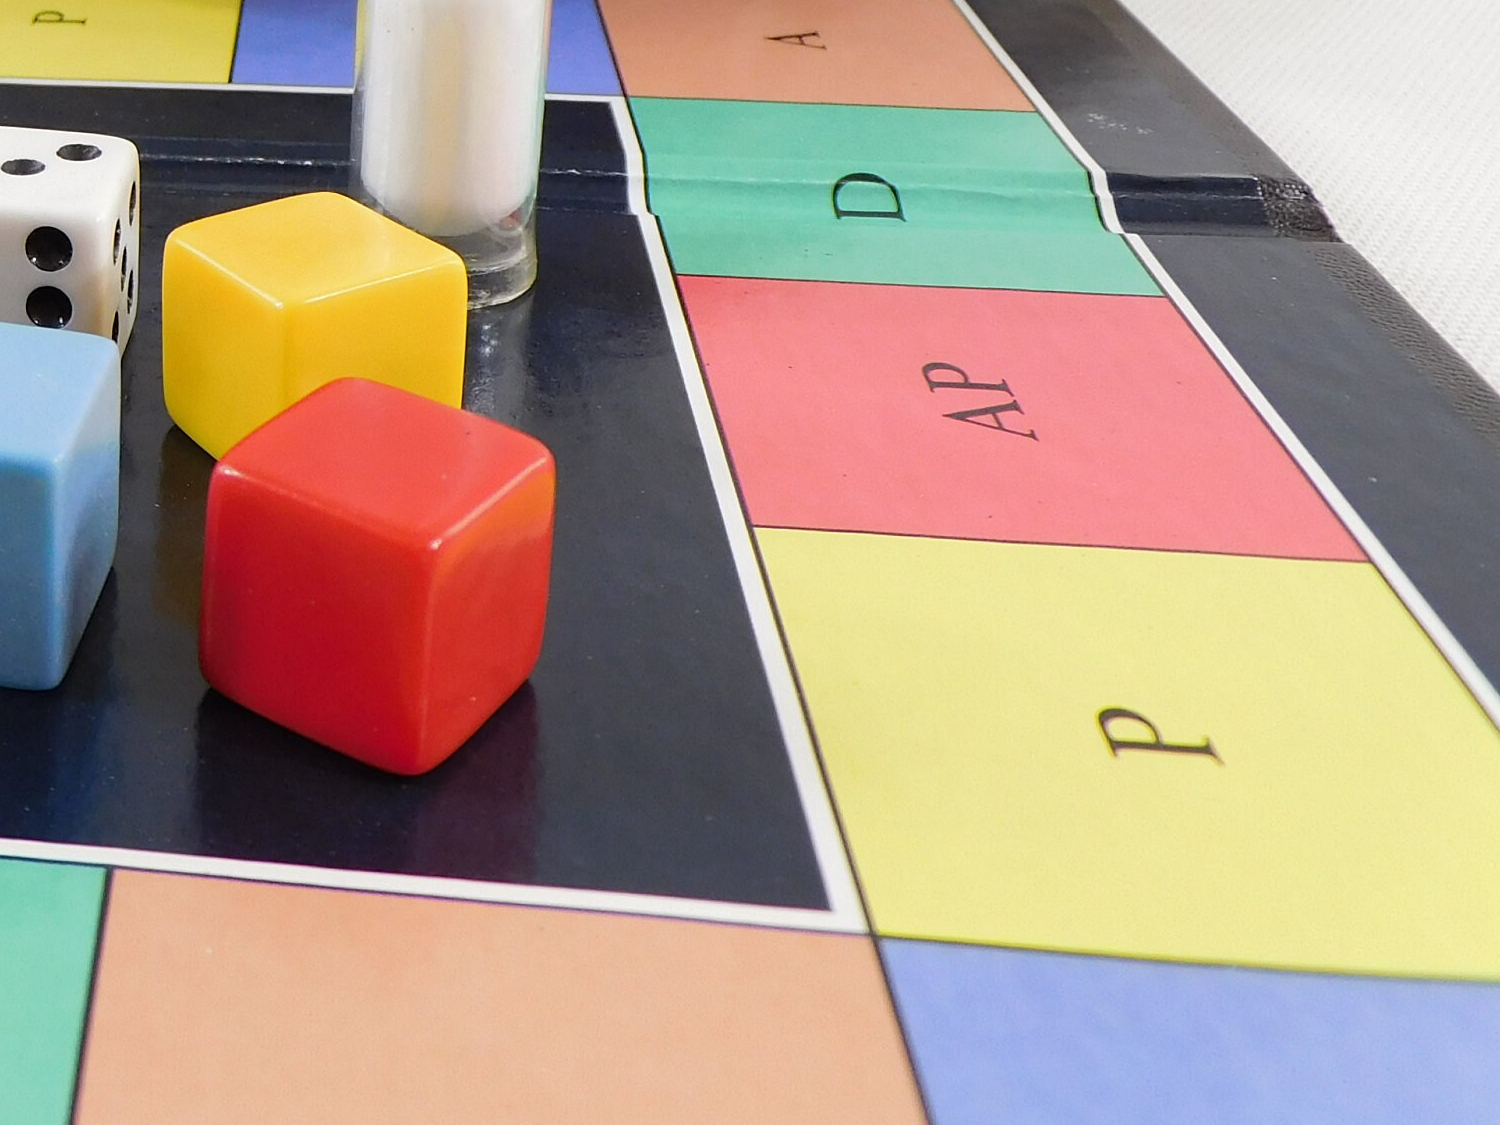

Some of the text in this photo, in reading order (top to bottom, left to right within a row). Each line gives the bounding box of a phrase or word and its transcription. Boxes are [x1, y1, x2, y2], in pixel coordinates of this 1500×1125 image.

[31, 9, 88, 26] P
[764, 30, 828, 52] A
[832, 172, 907, 223] D
[921, 362, 1040, 442] AP
[1096, 706, 1226, 766] P
